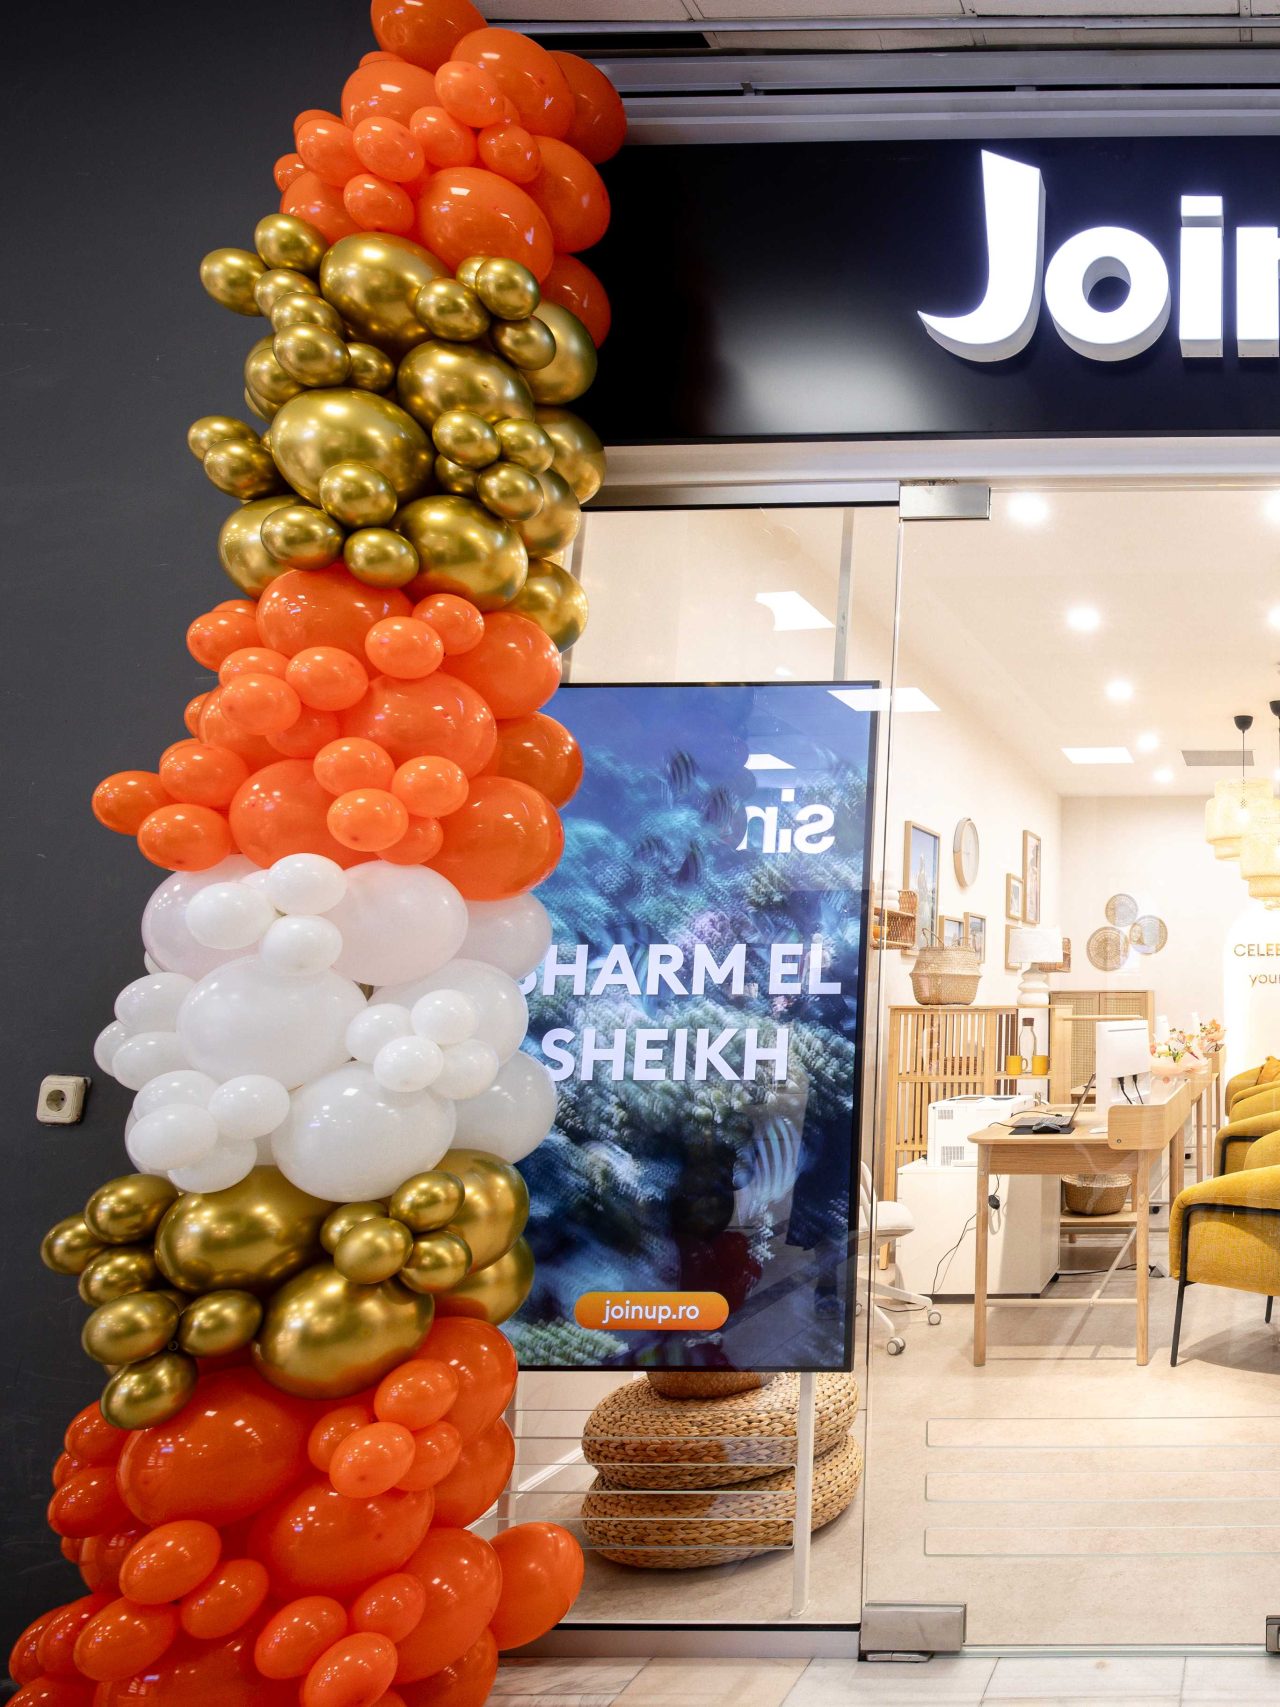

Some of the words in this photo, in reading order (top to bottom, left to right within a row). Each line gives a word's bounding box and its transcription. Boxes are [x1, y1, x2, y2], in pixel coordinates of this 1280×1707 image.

[768, 943, 843, 995] EL
[541, 1027, 789, 1082] SHEIKH
[601, 1299, 700, 1325] joinup.ro
